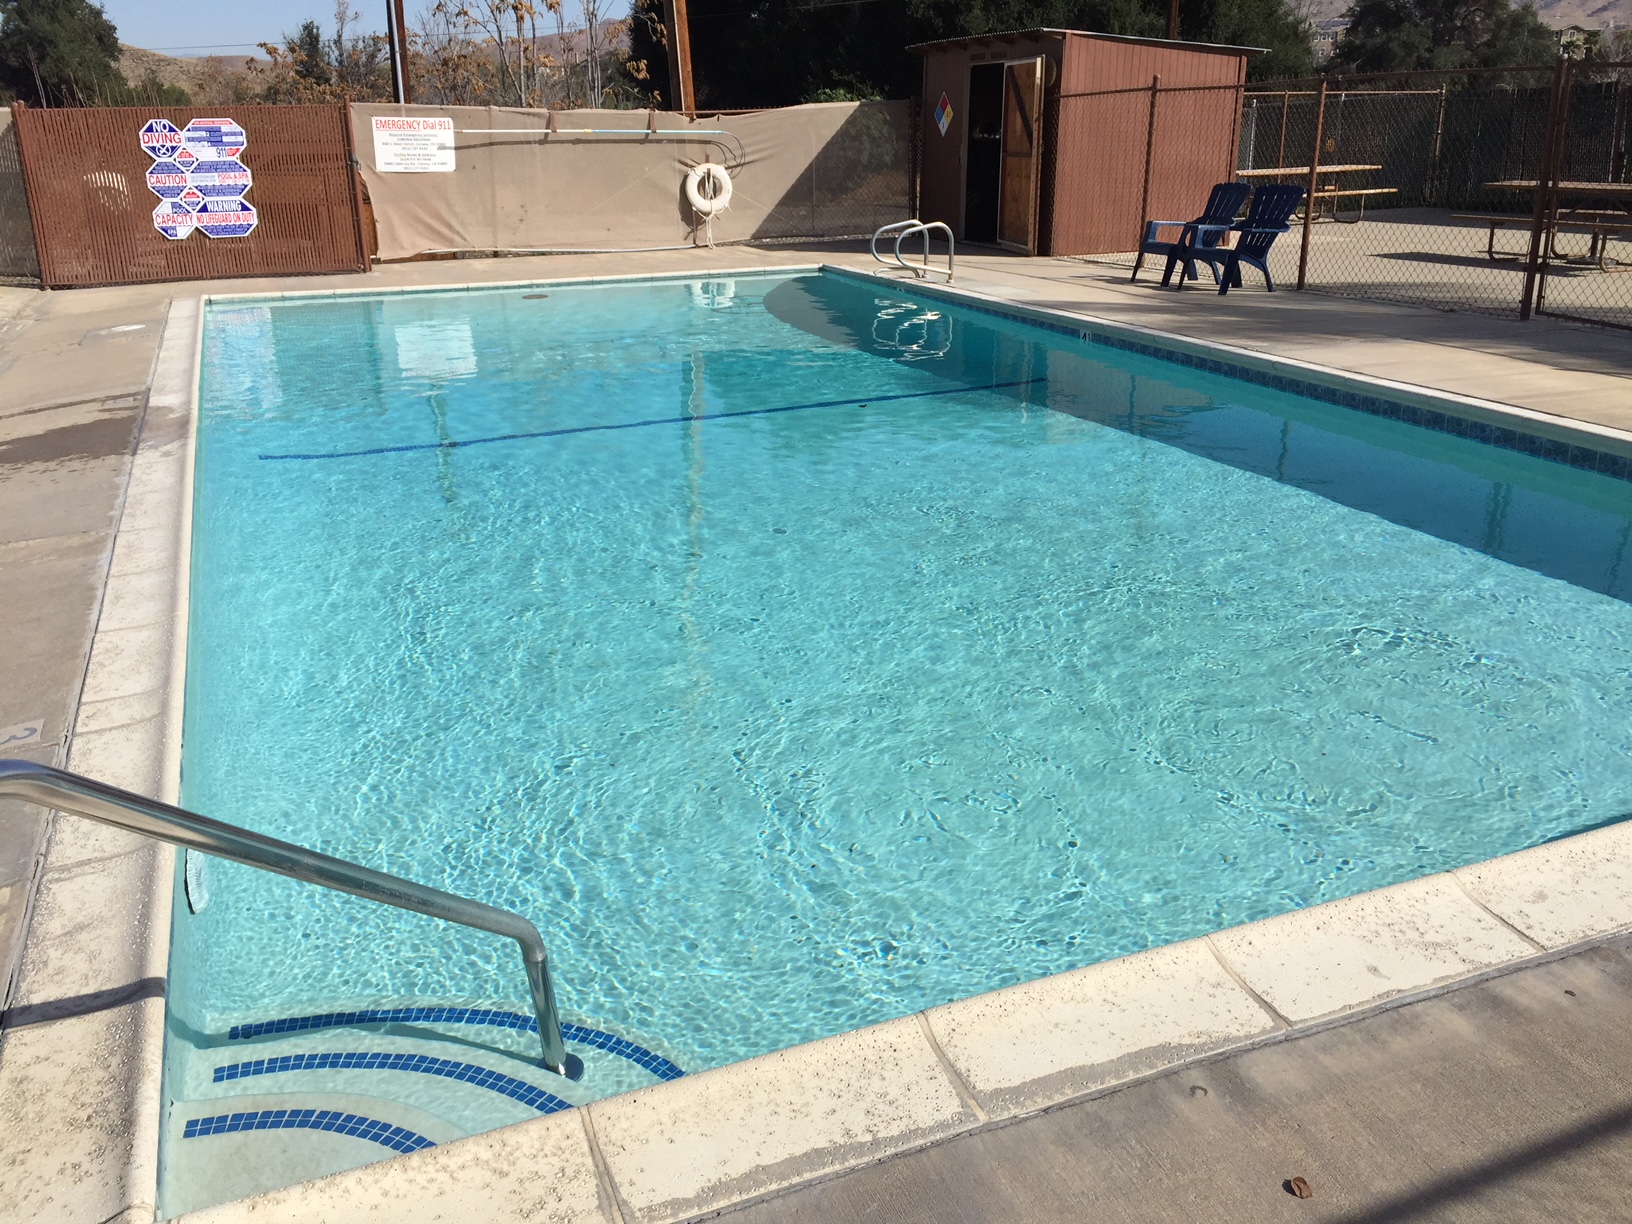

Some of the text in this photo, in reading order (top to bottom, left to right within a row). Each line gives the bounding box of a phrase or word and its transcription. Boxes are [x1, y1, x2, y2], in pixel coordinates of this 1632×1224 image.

[152, 121, 169, 132] NO
[375, 119, 451, 130] EMERGENCY Dial 911
[142, 133, 182, 144] DIVING
[216, 147, 227, 158] 911
[148, 174, 187, 185] CAUTION
[206, 200, 242, 212] WARNING
[155, 214, 193, 225] CAPACITY
[196, 212, 255, 224] NO LIFEGUARD ON DUTY
